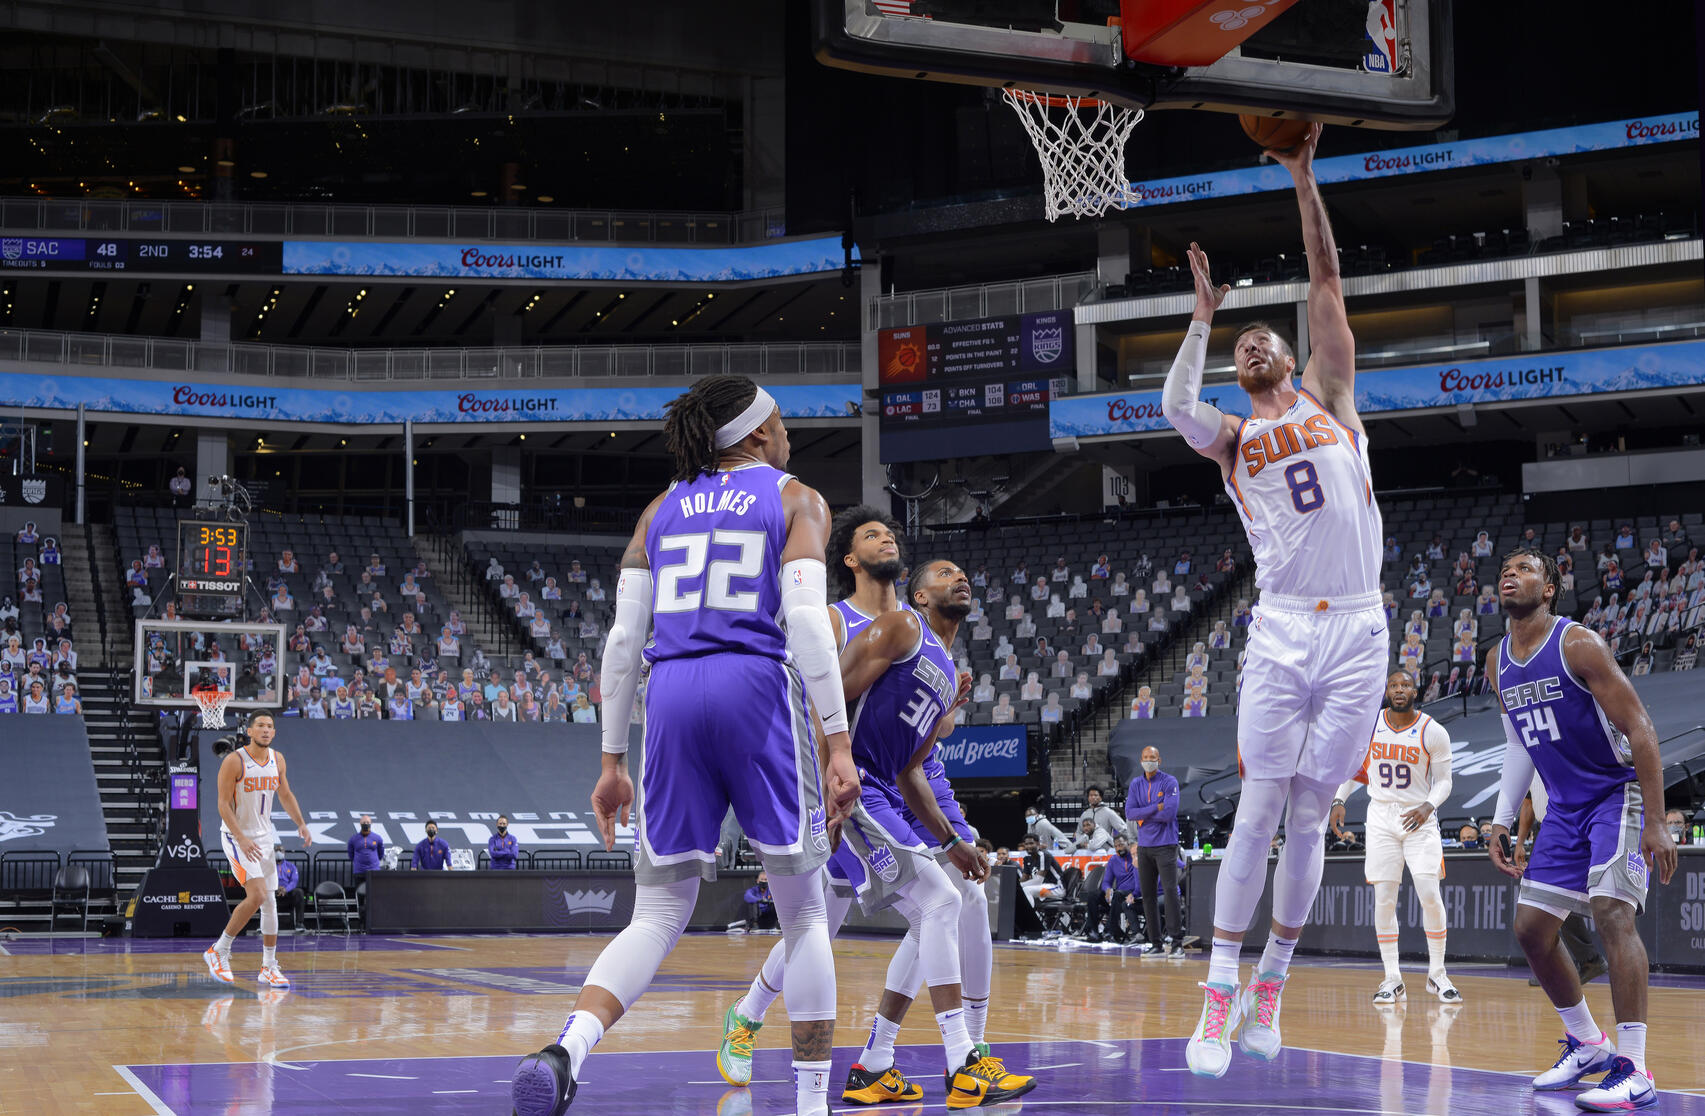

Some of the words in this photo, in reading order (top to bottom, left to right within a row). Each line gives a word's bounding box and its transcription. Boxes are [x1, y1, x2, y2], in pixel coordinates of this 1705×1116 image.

[1369, 53, 1385, 69] NBA
[1625, 121, 1677, 139] Coors
[1363, 153, 1411, 172] Coors
[1412, 150, 1453, 166] LIGHT
[1175, 181, 1213, 195] LIGHT
[27, 242, 58, 255] SAC
[97, 243, 117, 256] 48
[140, 245, 168, 257] 2ND
[189, 245, 223, 258] 3:54
[242, 248, 254, 256] 24
[2, 260, 37, 268] TIMEOUTS
[461, 248, 515, 267] Coors
[517, 255, 564, 268] LIGHT
[943, 323, 981, 335] ADVANCED
[981, 321, 1004, 331] STATS
[1036, 316, 1057, 324] KINGS
[893, 331, 911, 340] SUNS
[952, 340, 981, 349] EFFECTIVE
[1034, 341, 1060, 351] KINGS
[945, 353, 966, 361] POINTS
[985, 349, 1003, 357] PAINT
[973, 361, 1004, 370] TURNOVERS
[1022, 382, 1037, 391] ORL
[1439, 368, 1505, 392] Coors
[1508, 367, 1564, 386] LIGHT
[173, 386, 227, 407] Coors
[230, 394, 276, 409] LIGHT
[896, 394, 912, 402] DAL
[925, 391, 938, 400] 124
[959, 388, 976, 397] BKN
[1022, 393, 1040, 402] WAS
[457, 393, 510, 412] Coors
[512, 398, 558, 411] LIGHT
[896, 405, 912, 414] LAC
[959, 399, 976, 408] CHA
[1241, 414, 1338, 477] SUNS
[1110, 476, 1129, 496] 103
[1284, 460, 1325, 514] 8
[680, 489, 757, 519] HOLMES
[201, 527, 237, 546] 3:53
[205, 547, 231, 576] 13
[654, 528, 767, 614] 22
[198, 581, 240, 591] TISSOT
[1501, 676, 1564, 711] SAC
[900, 688, 941, 737] 30
[1517, 706, 1561, 747] 24
[964, 738, 1019, 765] Breeze
[1372, 742, 1420, 765] SUNS
[170, 766, 198, 774] SPALDING
[1379, 763, 1411, 789] 99
[244, 776, 280, 792] SUNS
[261, 794, 265, 815] 1
[167, 845, 200, 862] vsp
[874, 855, 895, 873] SAC
[143, 896, 177, 904] CACHE
[191, 894, 222, 903] CREEK
[1408, 885, 1466, 929] UER
[1472, 885, 1507, 929] THE
[1680, 902, 1705, 931] SO
